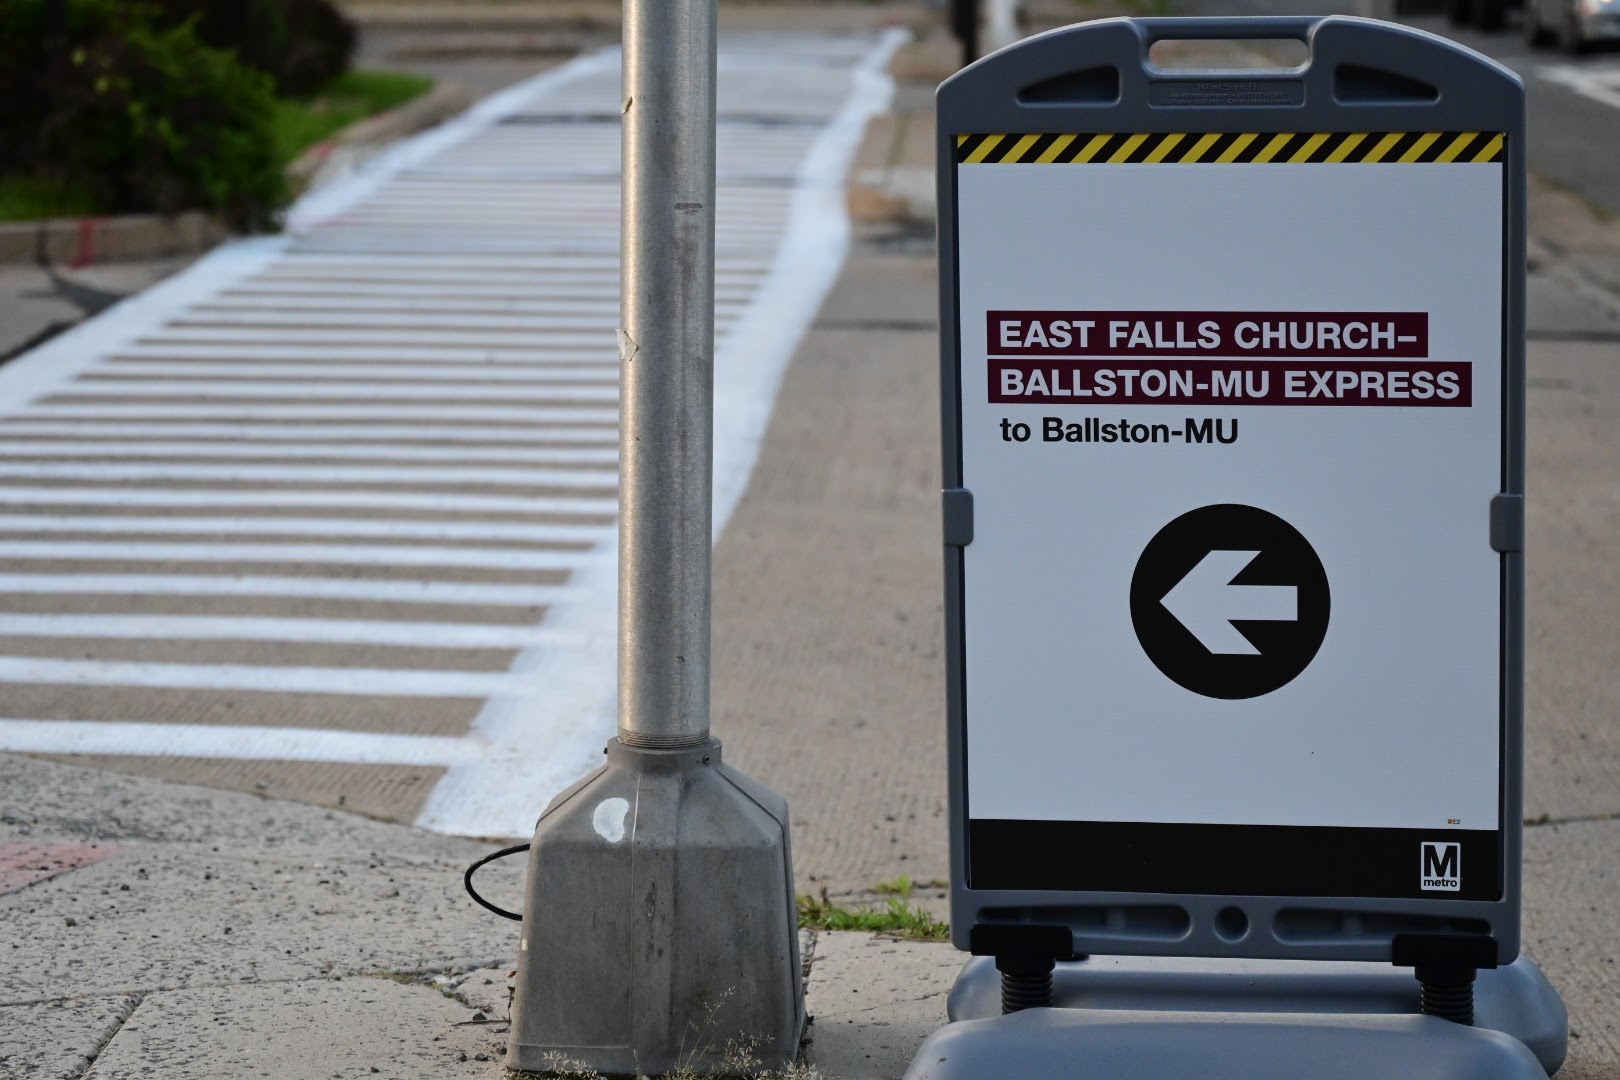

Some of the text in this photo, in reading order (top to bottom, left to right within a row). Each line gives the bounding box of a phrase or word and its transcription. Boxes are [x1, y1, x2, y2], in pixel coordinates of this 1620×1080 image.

[999, 320, 1096, 348] EAST
[1109, 320, 1221, 349] FALLS
[1000, 368, 1460, 400] BALLSTON-MU EXPRESS
[1000, 416, 1238, 445] to Ballston-MU
[1424, 845, 1457, 877] M
[1424, 878, 1457, 887] metro
